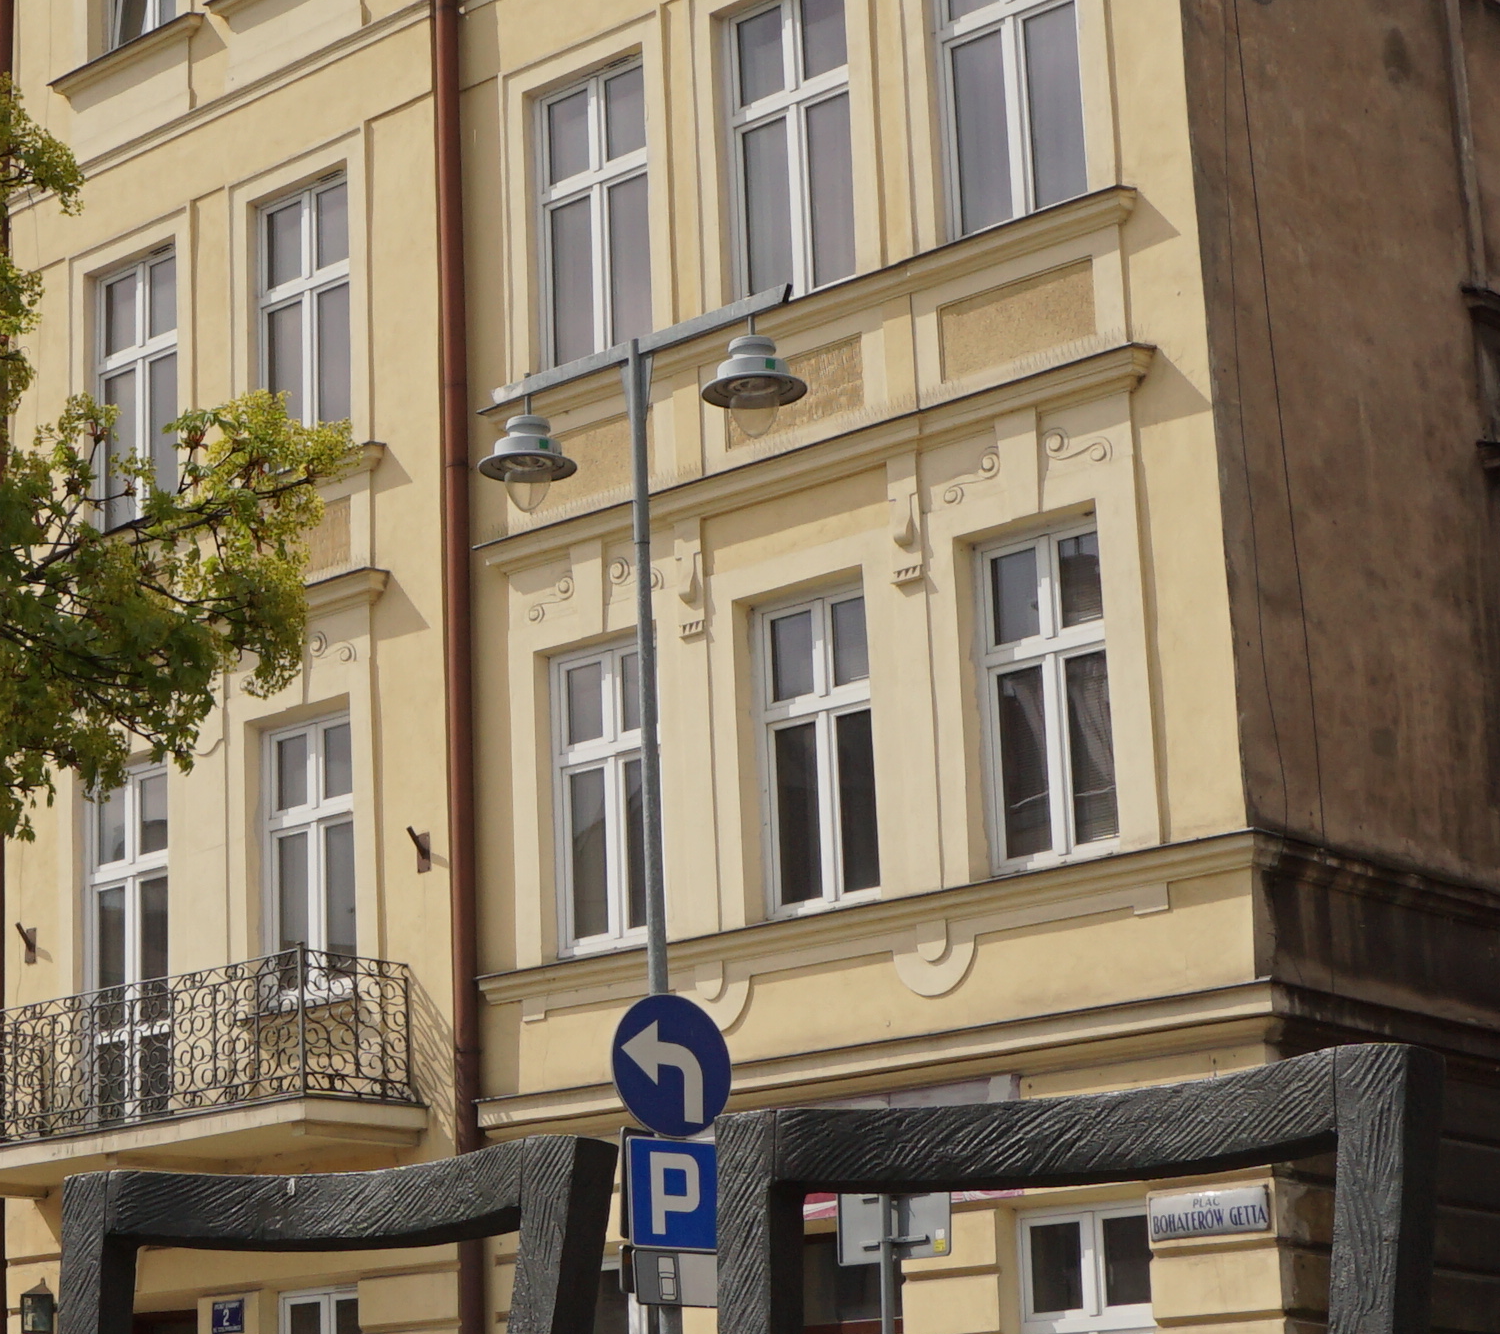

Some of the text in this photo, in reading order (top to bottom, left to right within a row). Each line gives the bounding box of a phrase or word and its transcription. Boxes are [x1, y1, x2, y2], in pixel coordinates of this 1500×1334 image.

[650, 1151, 700, 1235] P
[1193, 1197, 1220, 1208] PLAC
[1152, 1204, 1267, 1235] BOHATERÓW GETTA
[222, 1308, 230, 1326] 2
